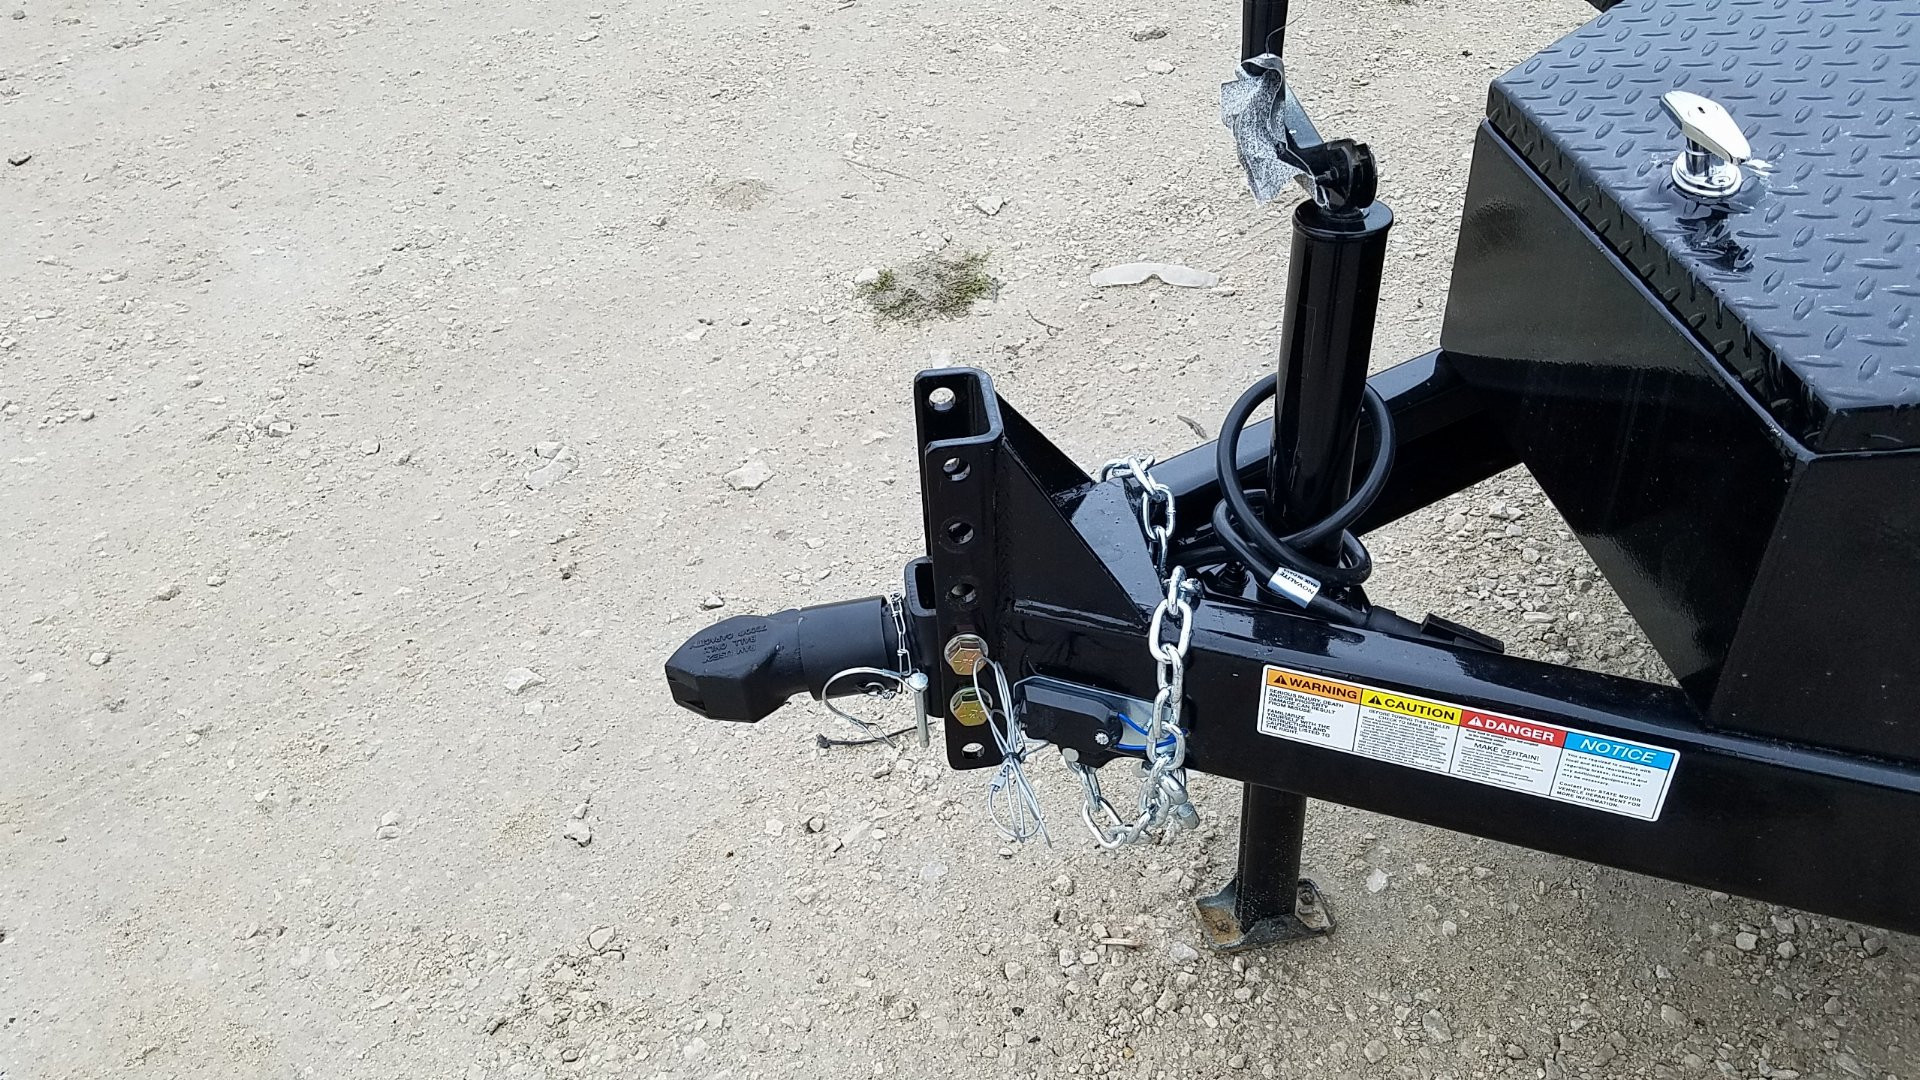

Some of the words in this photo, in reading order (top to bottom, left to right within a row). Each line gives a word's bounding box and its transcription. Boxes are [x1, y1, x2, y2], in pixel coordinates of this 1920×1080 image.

[1280, 572, 1314, 595] NOVALITE
[1270, 689, 1296, 698] SERIOUS
[1298, 695, 1321, 704] INJURY,
[1289, 678, 1357, 700] WARNING
[1268, 708, 1305, 720] FAMILIARIZE
[1269, 697, 1295, 706] DAMAGE
[1312, 706, 1335, 714] RESULT
[1384, 698, 1455, 721] CAUTION
[1267, 713, 1298, 723] YOURSELF
[1267, 717, 1311, 729] INSTRUCTIONS
[1266, 720, 1297, 730] CAUTIONS
[1299, 728, 1320, 736] LISTED
[1484, 719, 1555, 742] DANGER
[1474, 742, 1499, 752] MAKE
[1500, 748, 1540, 761] CERTAIN!
[1580, 738, 1657, 764] NOTICE
[1558, 786, 1584, 795] VEHICLE
[1585, 792, 1626, 804] DEPARTMENT
